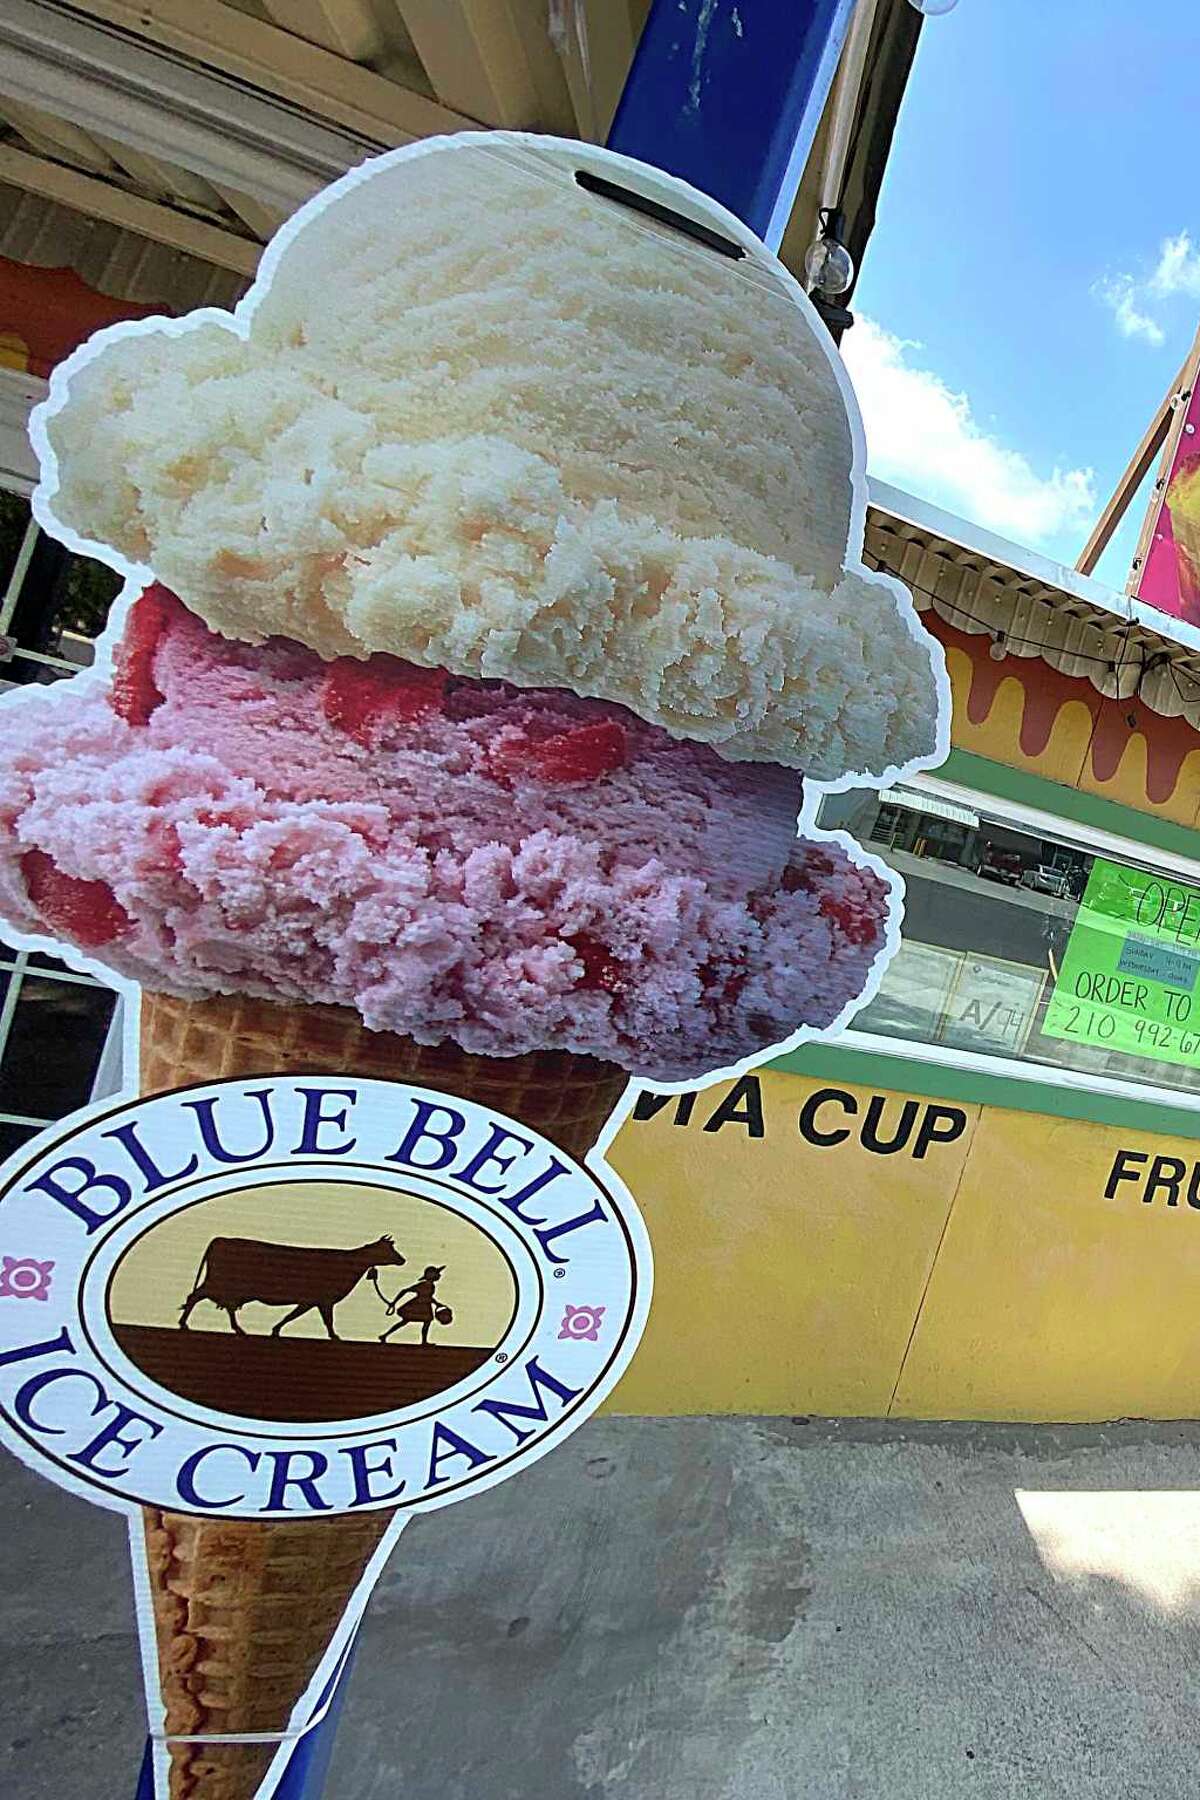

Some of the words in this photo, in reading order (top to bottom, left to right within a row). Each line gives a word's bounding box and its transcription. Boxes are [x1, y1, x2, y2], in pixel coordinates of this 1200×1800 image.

[1064, 1006, 1116, 1039] 210
[1075, 971, 1148, 1011] ORDER
[1165, 990, 1192, 1022] TO
[799, 1088, 967, 1159] CUP
[25, 1088, 359, 1235] BLUE
[385, 1099, 608, 1264] BELL
[0, 1326, 164, 1478] ICE
[176, 1355, 583, 1511] CREAM
